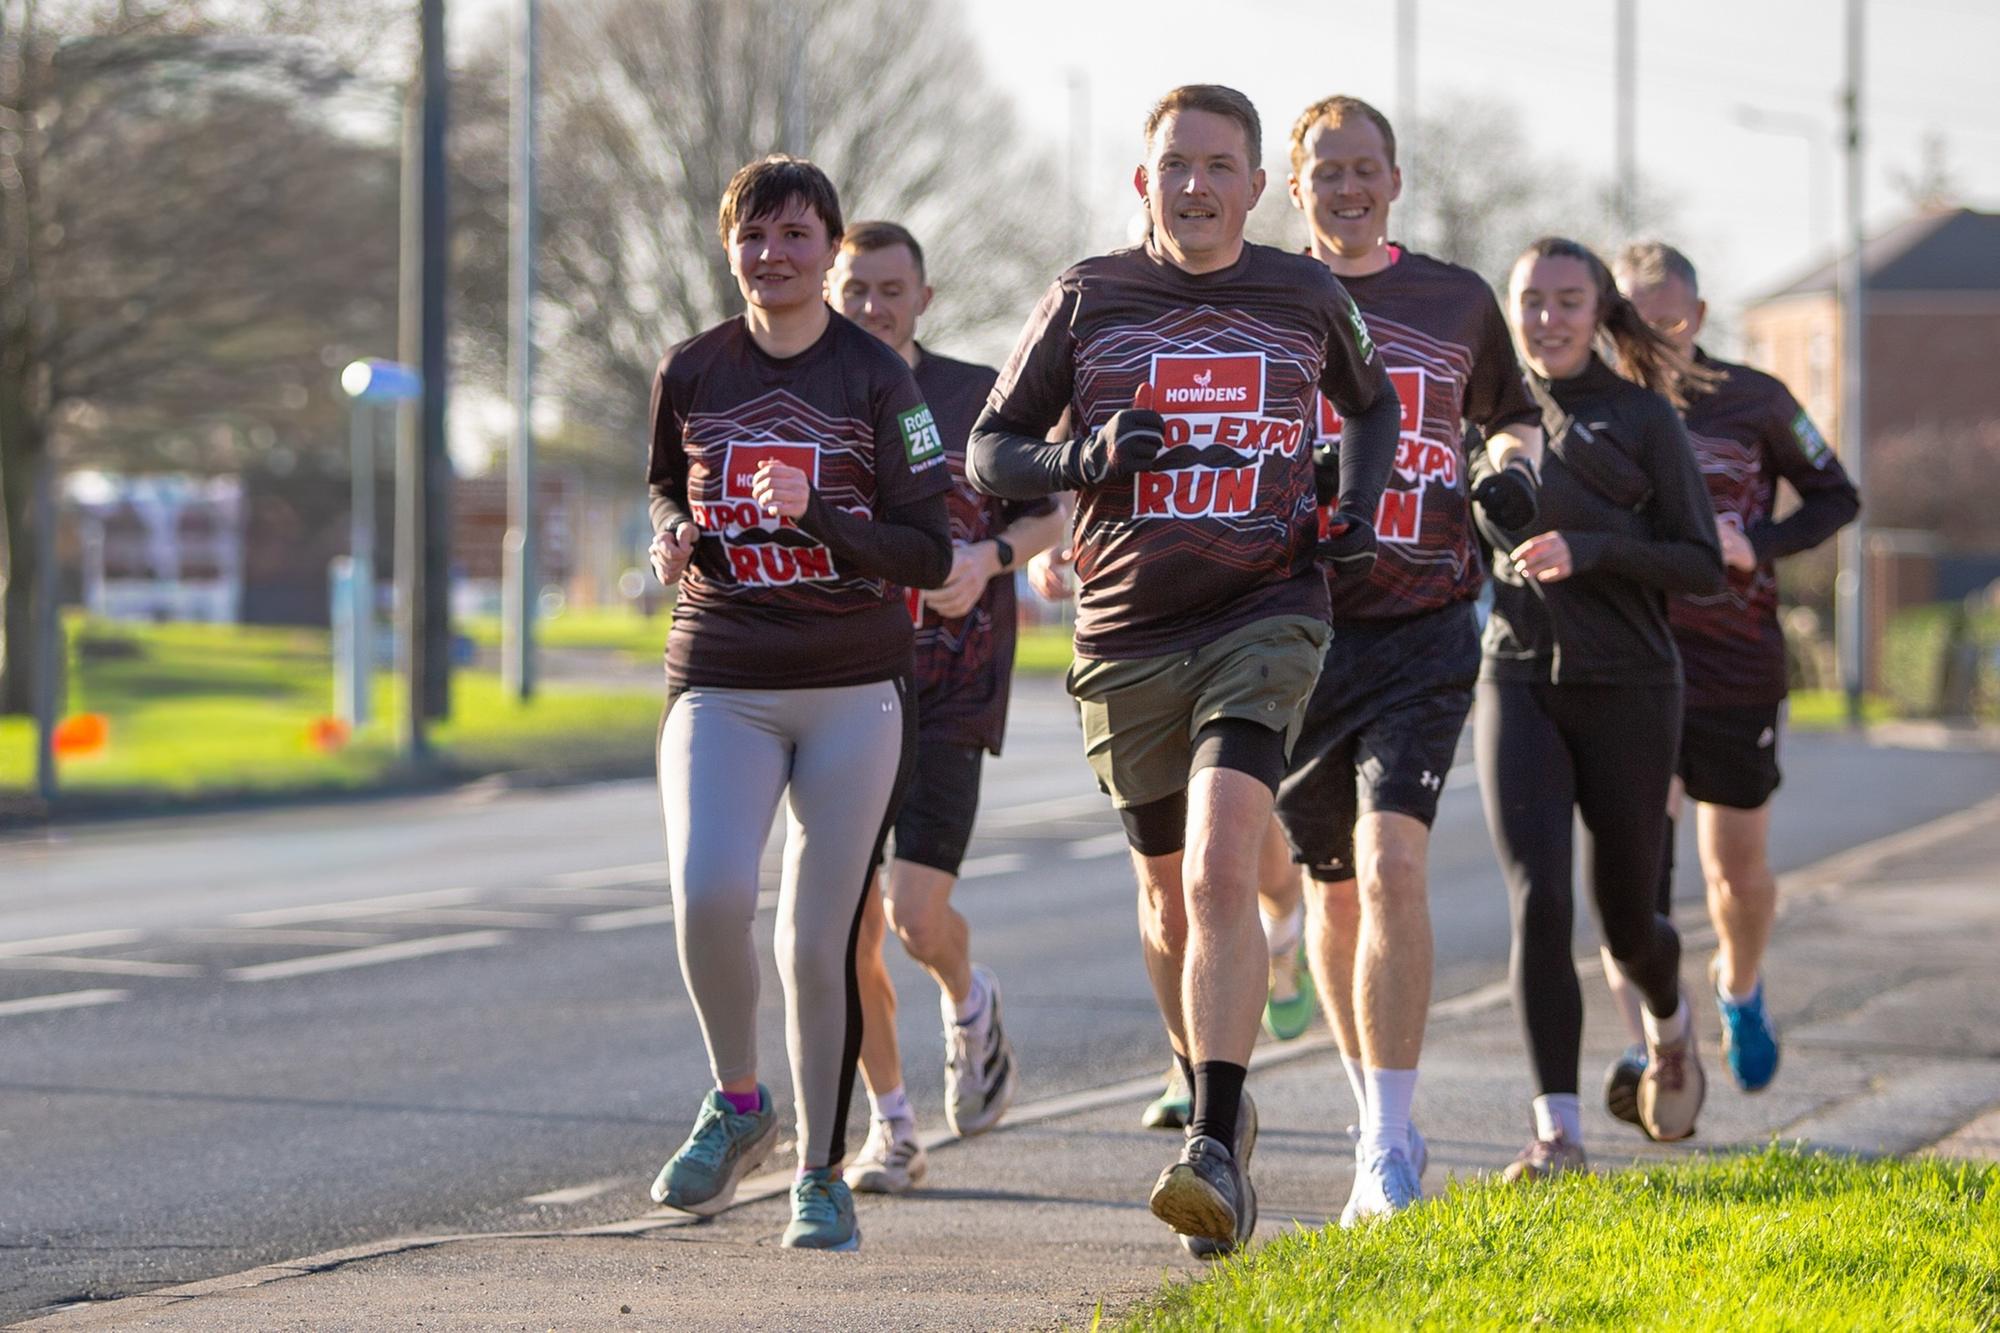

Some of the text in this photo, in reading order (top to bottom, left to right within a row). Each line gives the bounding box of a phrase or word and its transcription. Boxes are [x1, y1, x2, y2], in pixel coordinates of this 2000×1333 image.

[1166, 386, 1247, 402] HOWDENS
[1137, 467, 1256, 515] RUN
[728, 546, 832, 582] RUN
